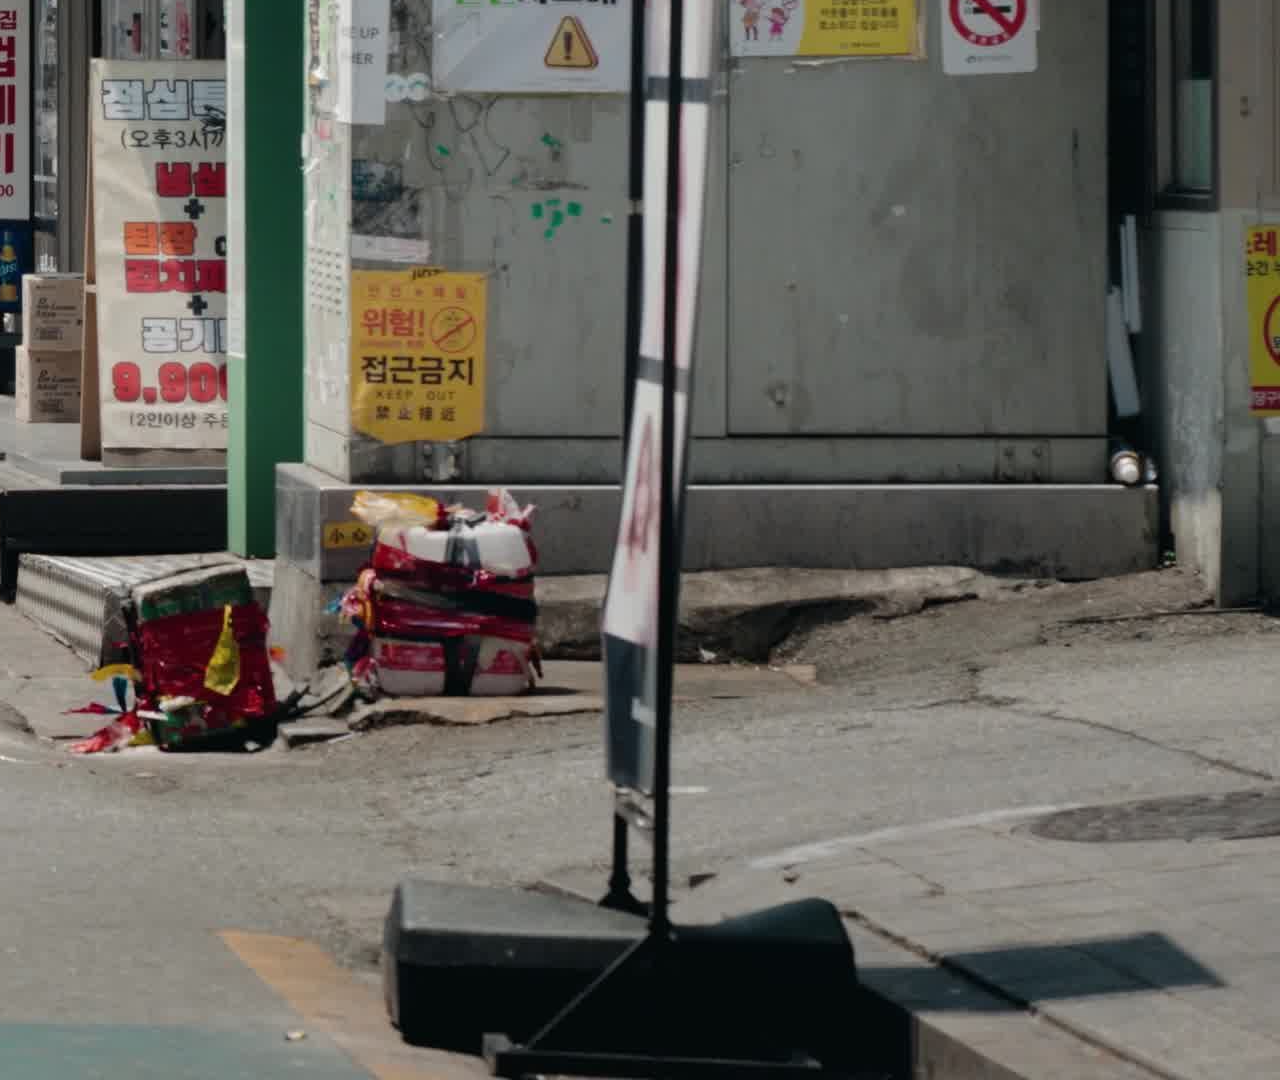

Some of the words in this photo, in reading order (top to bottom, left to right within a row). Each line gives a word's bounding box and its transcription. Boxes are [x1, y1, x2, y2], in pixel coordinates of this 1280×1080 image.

[360, 306, 425, 337] 위험!
[360, 354, 475, 386] 접근금지
[375, 390, 414, 401] KEEP
[425, 390, 457, 401] OUT
